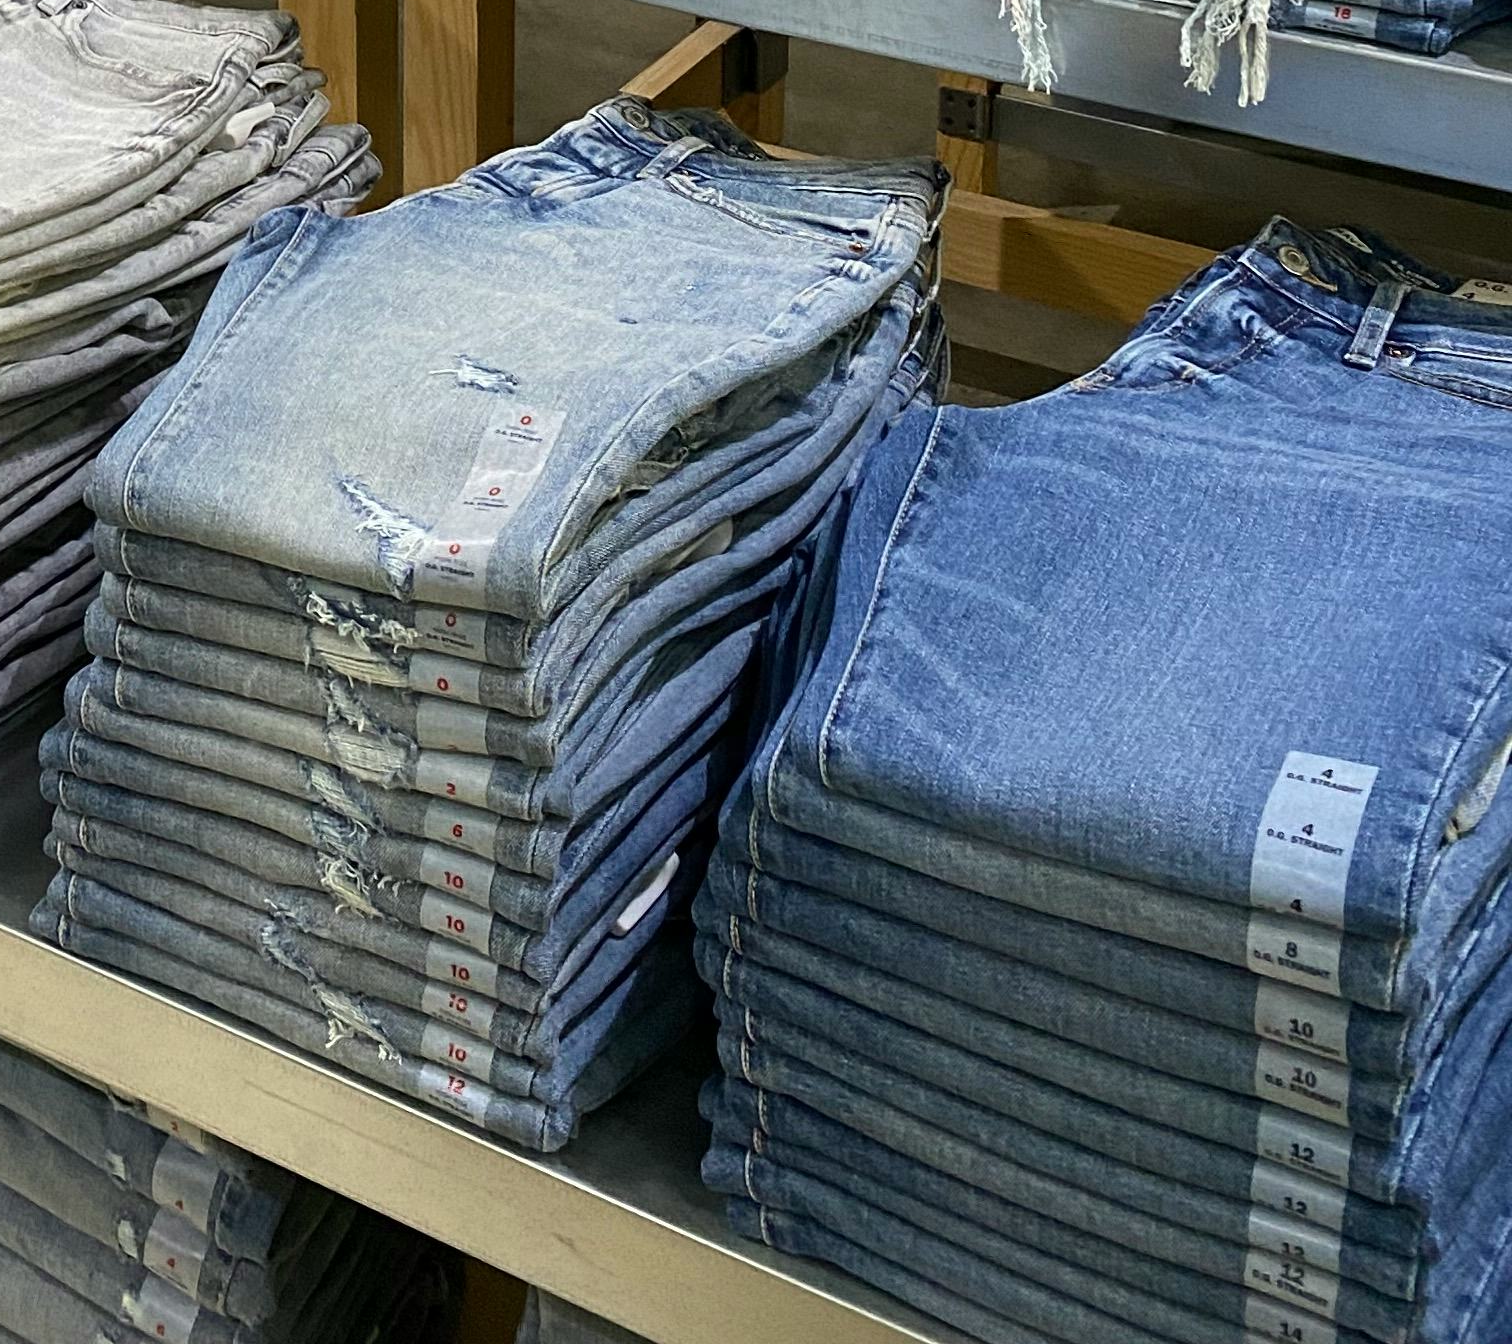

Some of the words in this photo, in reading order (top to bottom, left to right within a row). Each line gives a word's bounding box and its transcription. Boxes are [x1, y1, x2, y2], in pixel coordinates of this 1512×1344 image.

[1322, 769, 1334, 779] 4
[453, 824, 463, 838] 6
[1302, 824, 1314, 836] 4
[1267, 828, 1287, 841] O.G.
[1291, 835, 1344, 856] STRAIGHT
[444, 871, 464, 889] 10
[446, 915, 465, 933] 10
[1290, 1018, 1314, 1038] 10
[1292, 1067, 1317, 1088] 10
